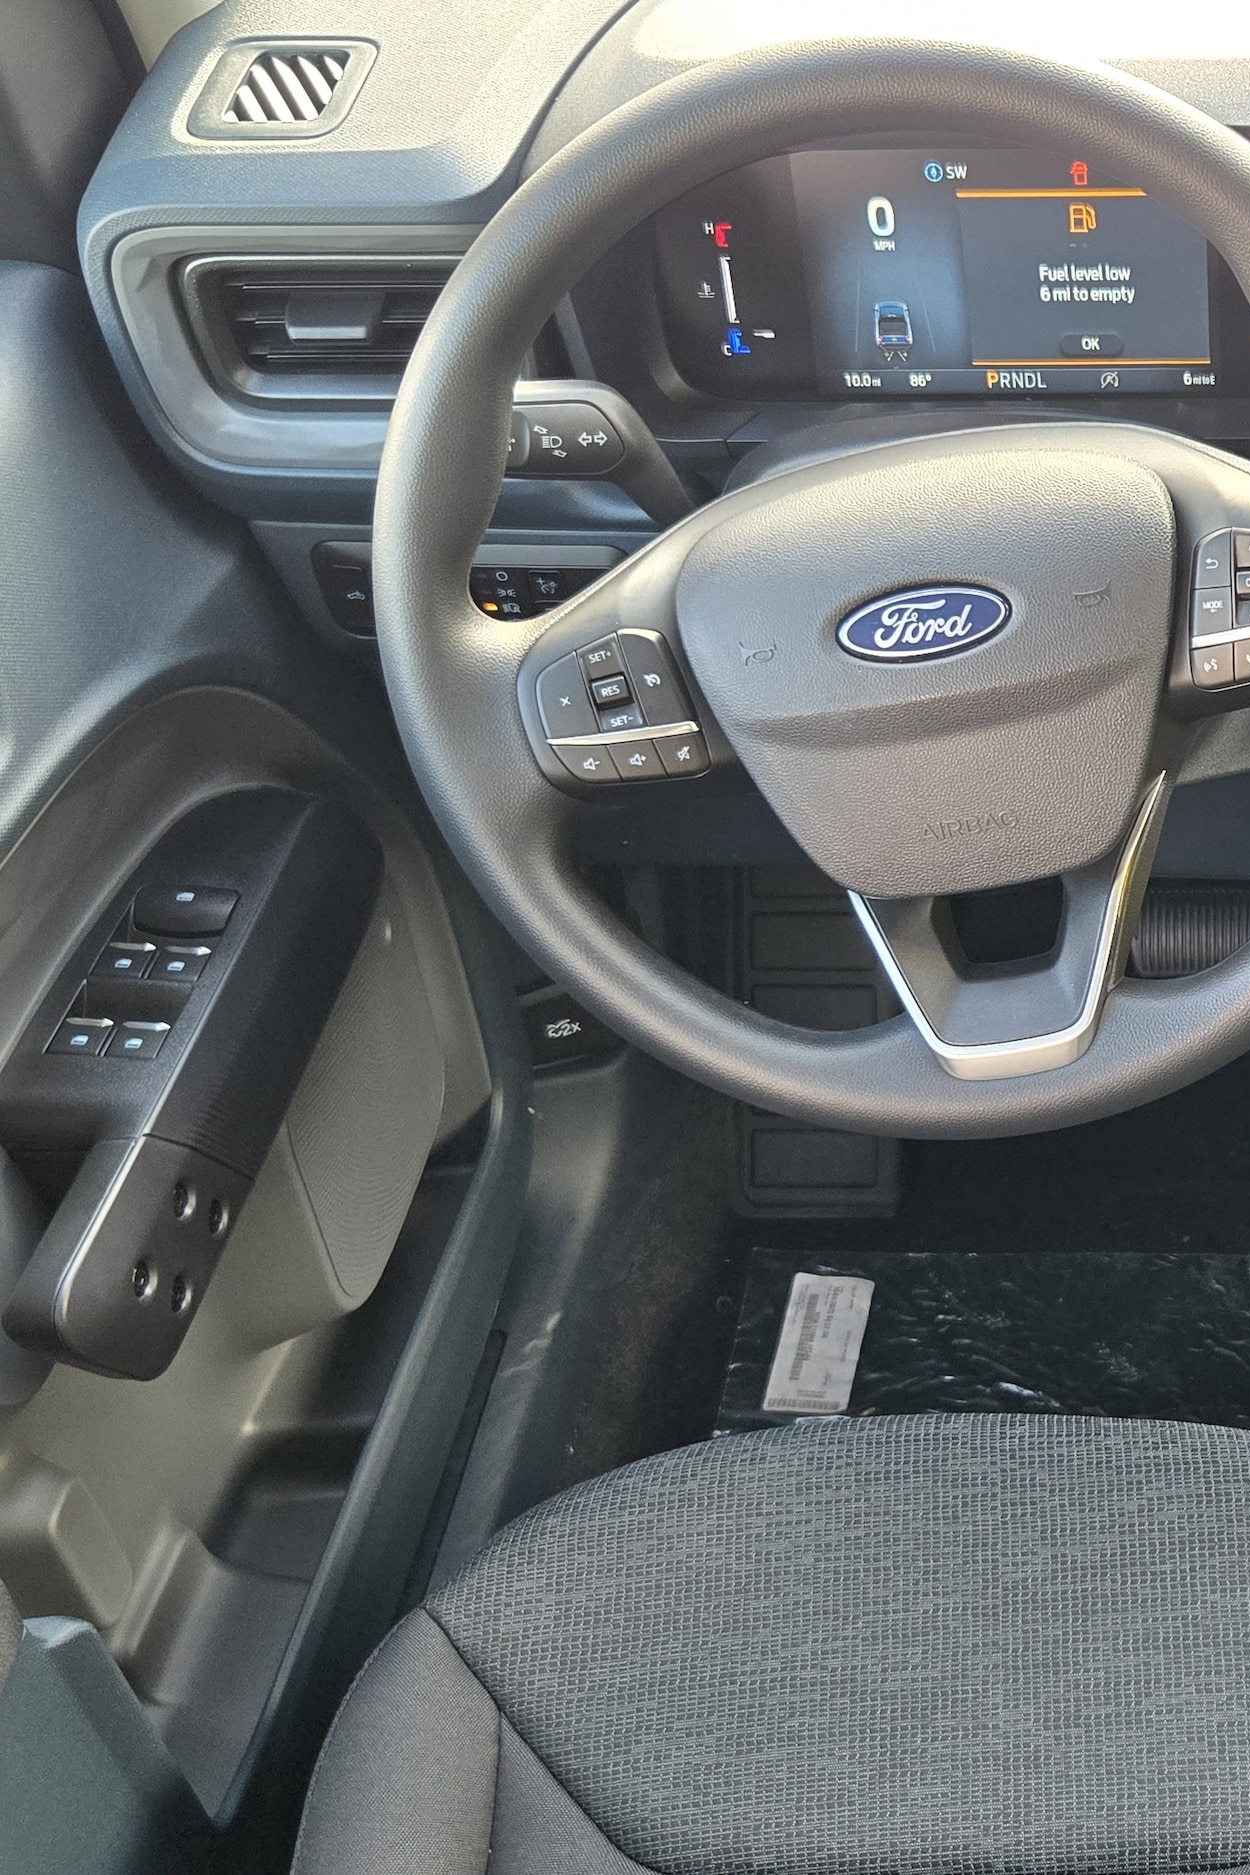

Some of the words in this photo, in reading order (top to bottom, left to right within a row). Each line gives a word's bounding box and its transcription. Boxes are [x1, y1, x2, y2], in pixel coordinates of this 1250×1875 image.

[945, 163, 968, 180] SW
[867, 195, 895, 237] 0
[704, 222, 715, 235] H
[873, 240, 896, 252] MPH
[1039, 264, 1070, 282] Fuel
[1070, 263, 1104, 282] level
[1105, 263, 1131, 281] low
[1040, 285, 1051, 302] 6
[1053, 285, 1071, 302] mi
[1073, 285, 1089, 302] to
[1090, 285, 1135, 304] empty
[1081, 336, 1101, 351] OK
[1202, 600, 1224, 610] MODE
[874, 598, 972, 650] Ford
[601, 685, 620, 697] RES
[921, 812, 1020, 842] AIRBAG
